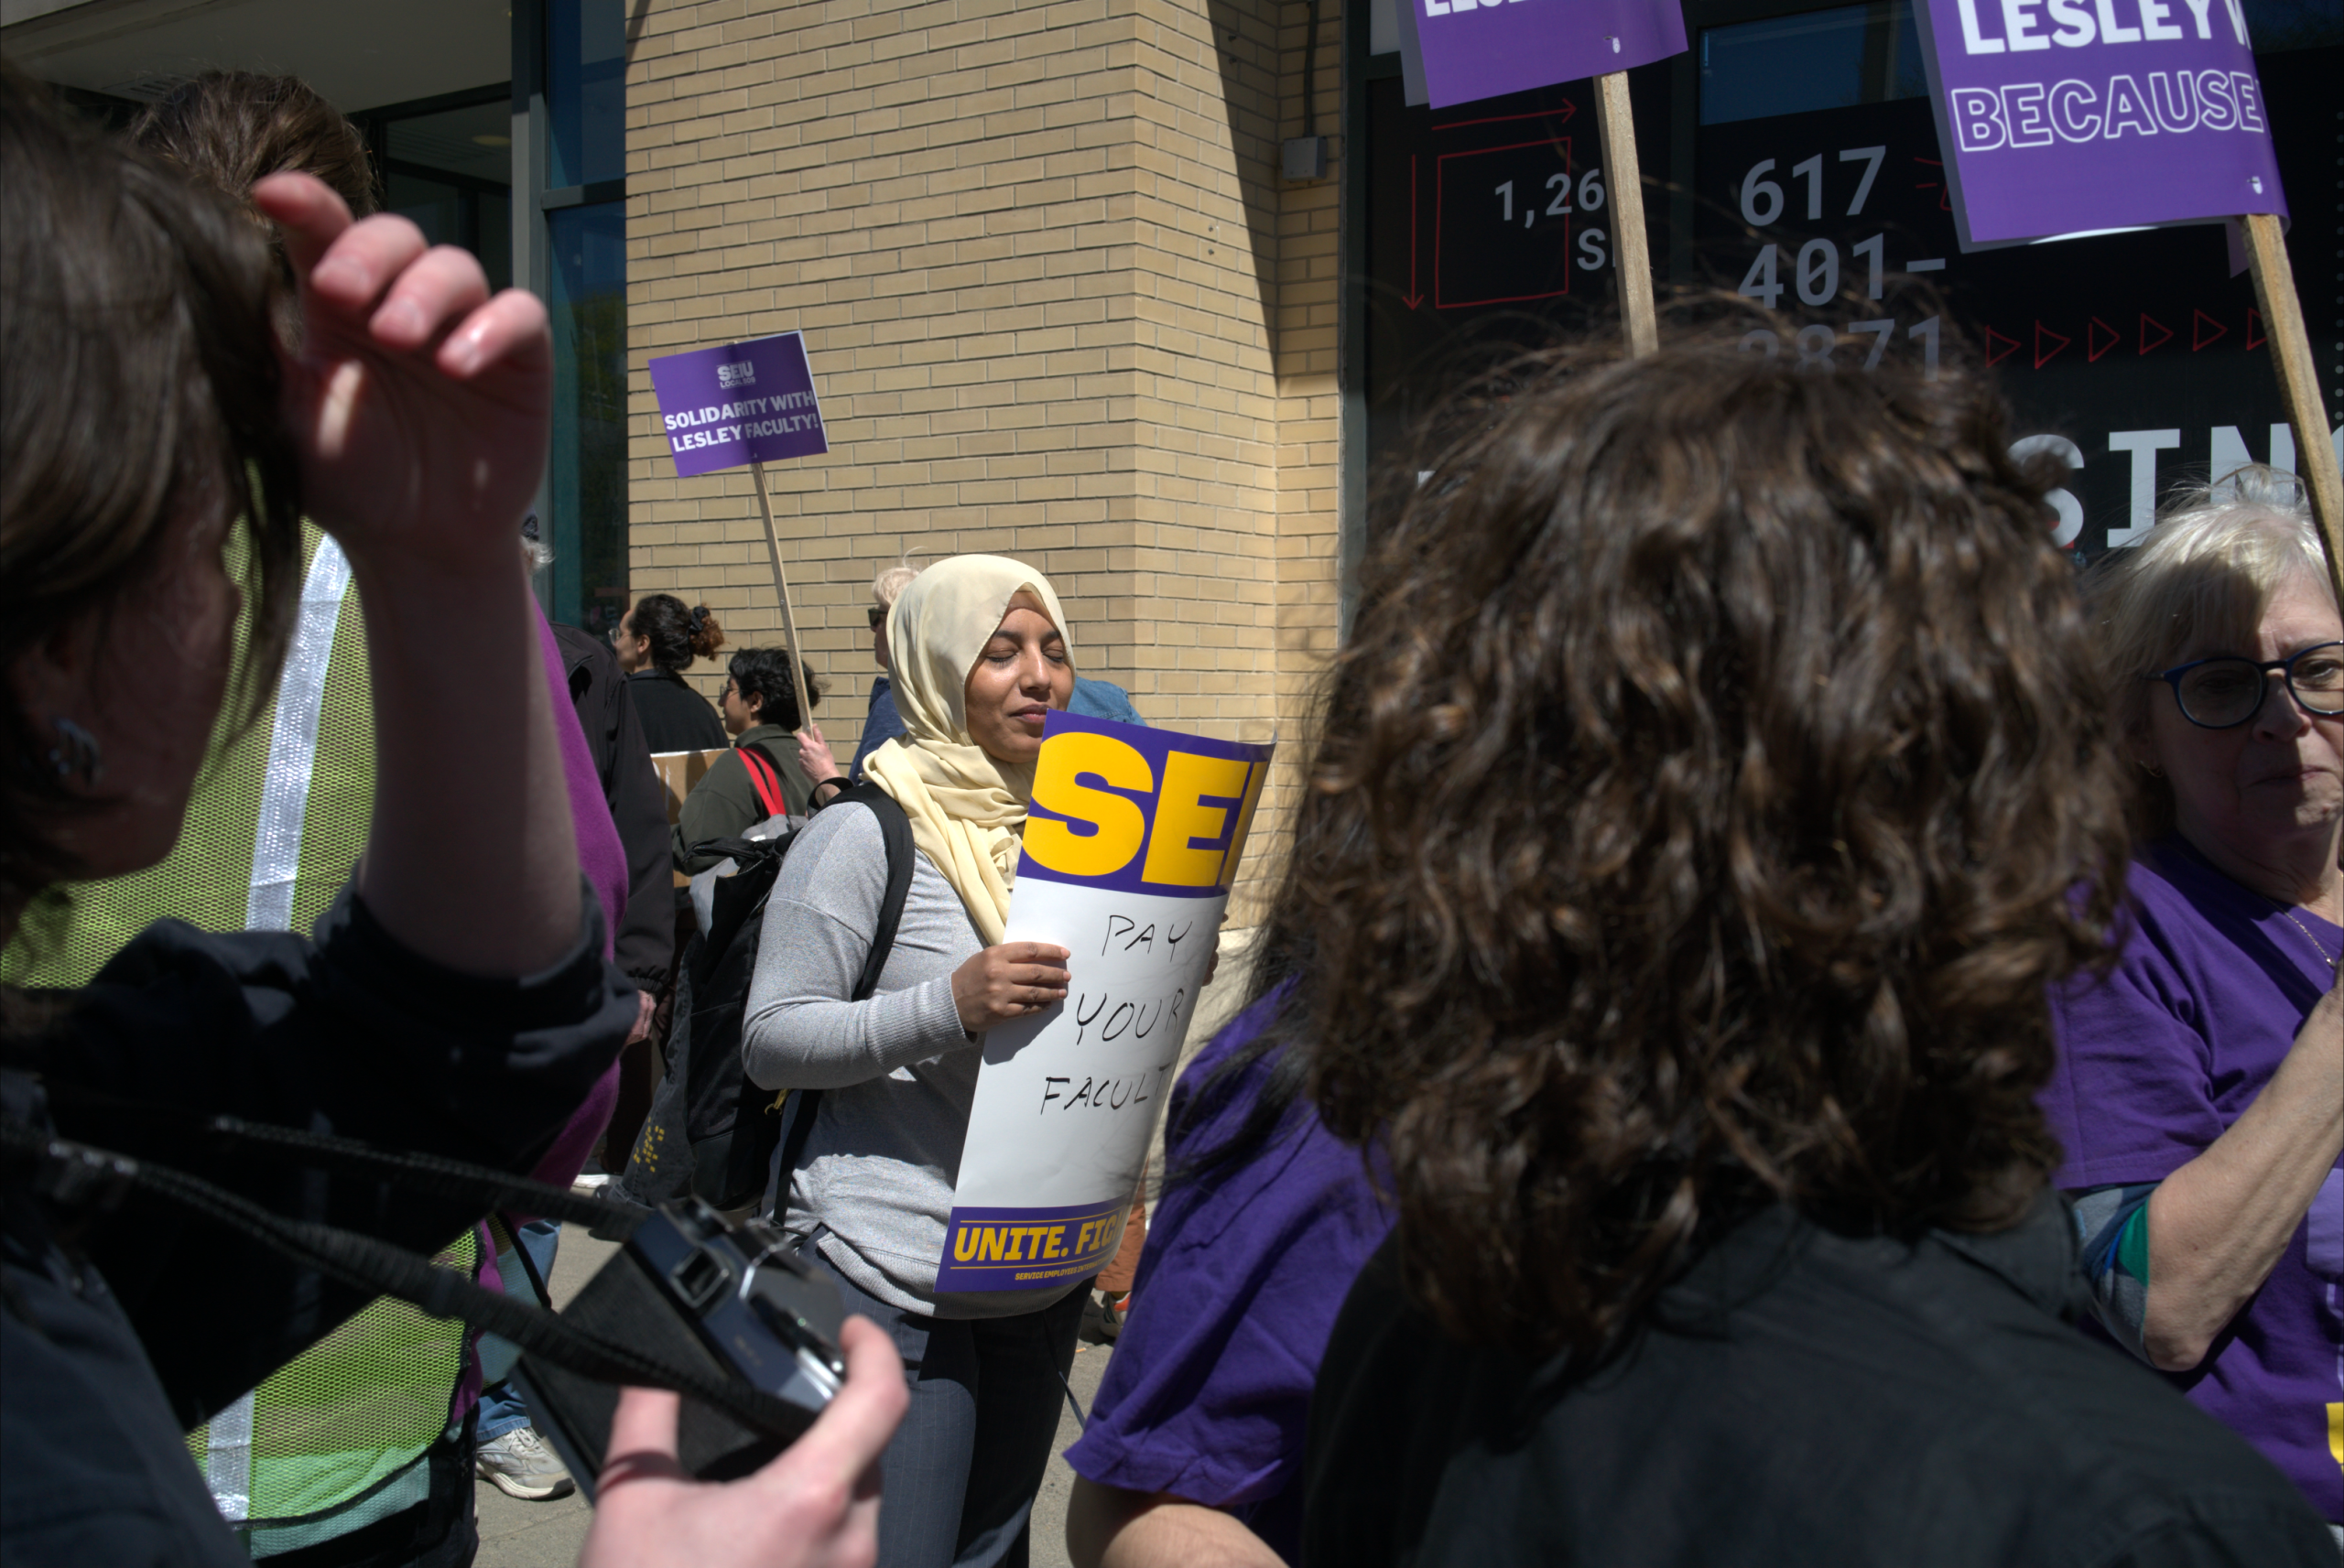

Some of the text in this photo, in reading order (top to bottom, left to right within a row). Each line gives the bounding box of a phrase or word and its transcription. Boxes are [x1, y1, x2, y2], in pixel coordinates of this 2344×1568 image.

[1957, 0, 2213, 55] LESLEY
[1951, 70, 2264, 152] BECAUSE
[1494, 168, 1607, 229] 1,26
[1740, 146, 1886, 227] 617
[1577, 228, 1618, 271] S
[717, 362, 754, 382] SEIU
[720, 378, 743, 388] LOCAL
[665, 390, 816, 430] SOLIDARITY WITH
[672, 413, 819, 452] LESLEY FACULTY!
[1101, 914, 1192, 963] PAY
[1076, 988, 1185, 1045] YOUR
[1040, 1062, 1171, 1115] FACULT
[954, 1209, 1128, 1262] UNITE. FIGH
[1015, 1271, 1044, 1281] SERVICE
[1044, 1266, 1077, 1279] EMPLOYEES
